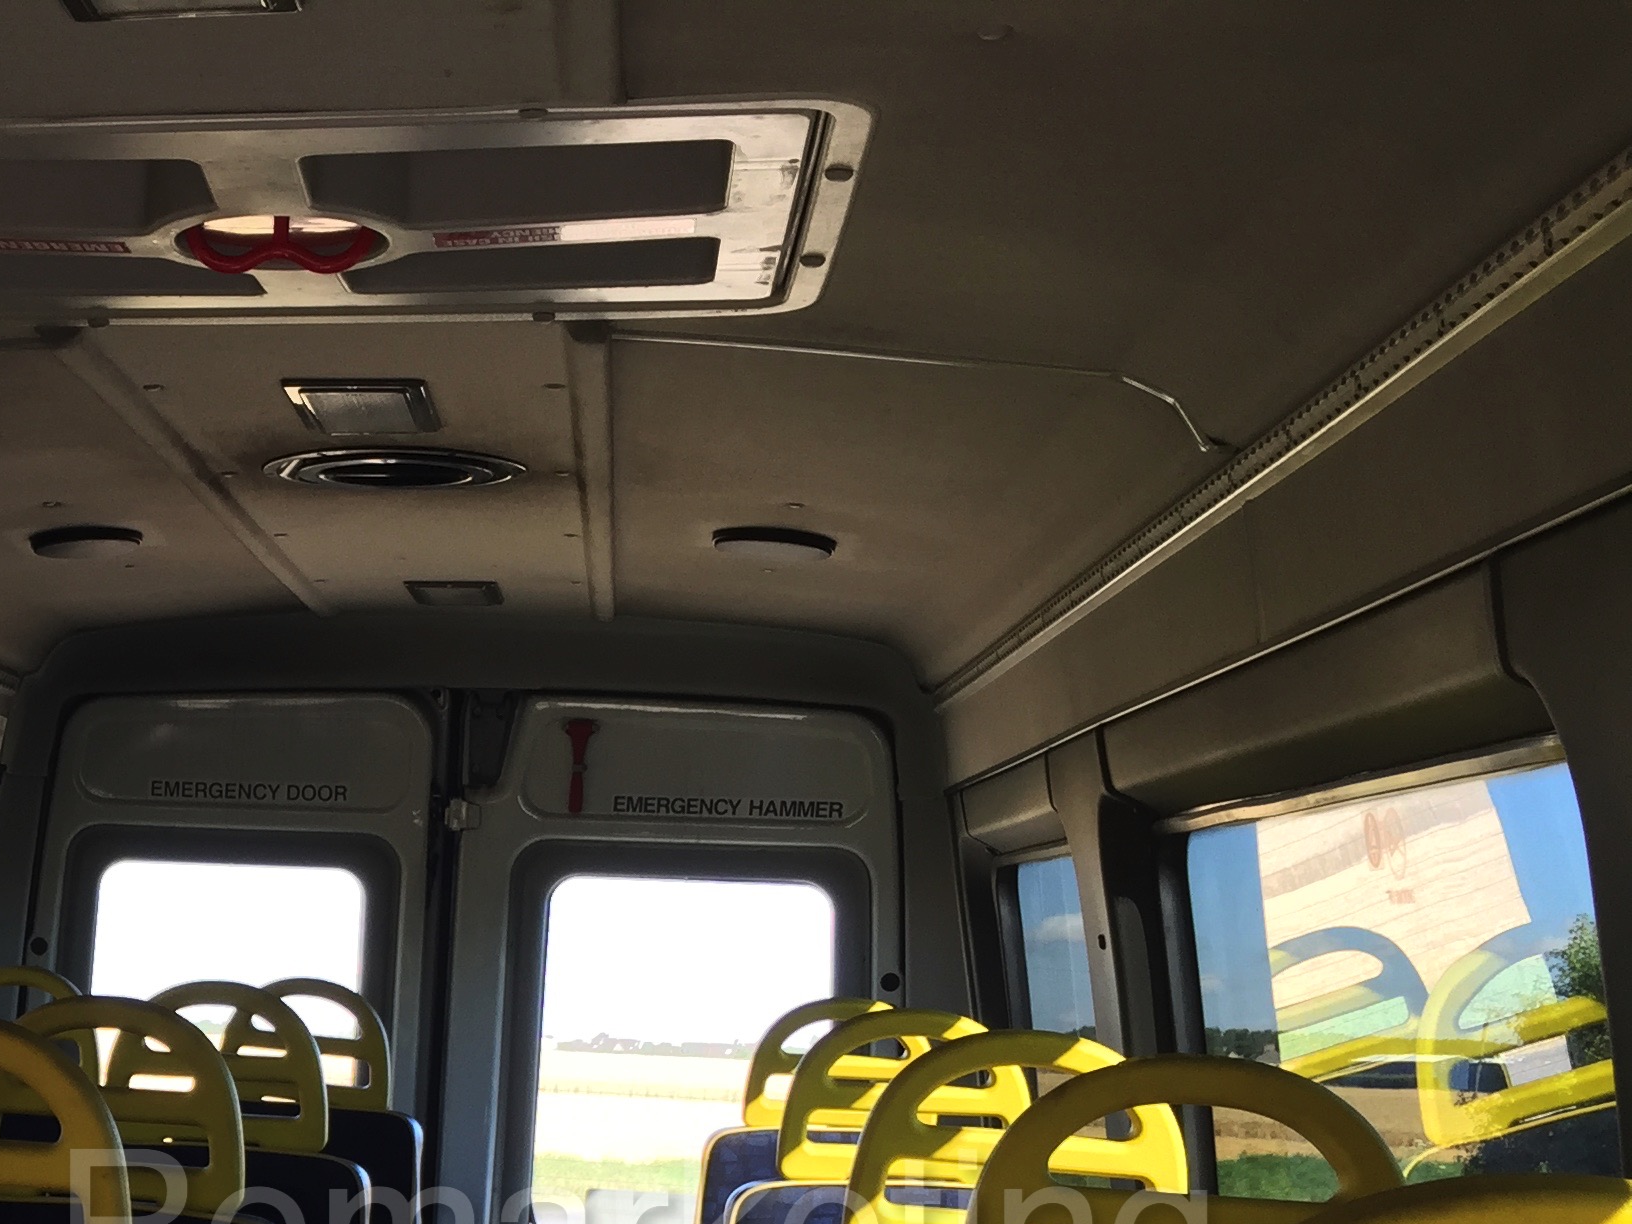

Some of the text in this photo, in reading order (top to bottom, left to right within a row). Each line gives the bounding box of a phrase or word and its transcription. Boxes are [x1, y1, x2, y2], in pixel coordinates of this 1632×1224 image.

[151, 780, 348, 801] EMERGENCY DOOR
[613, 795, 844, 819] EMERGENCY HAMMER
